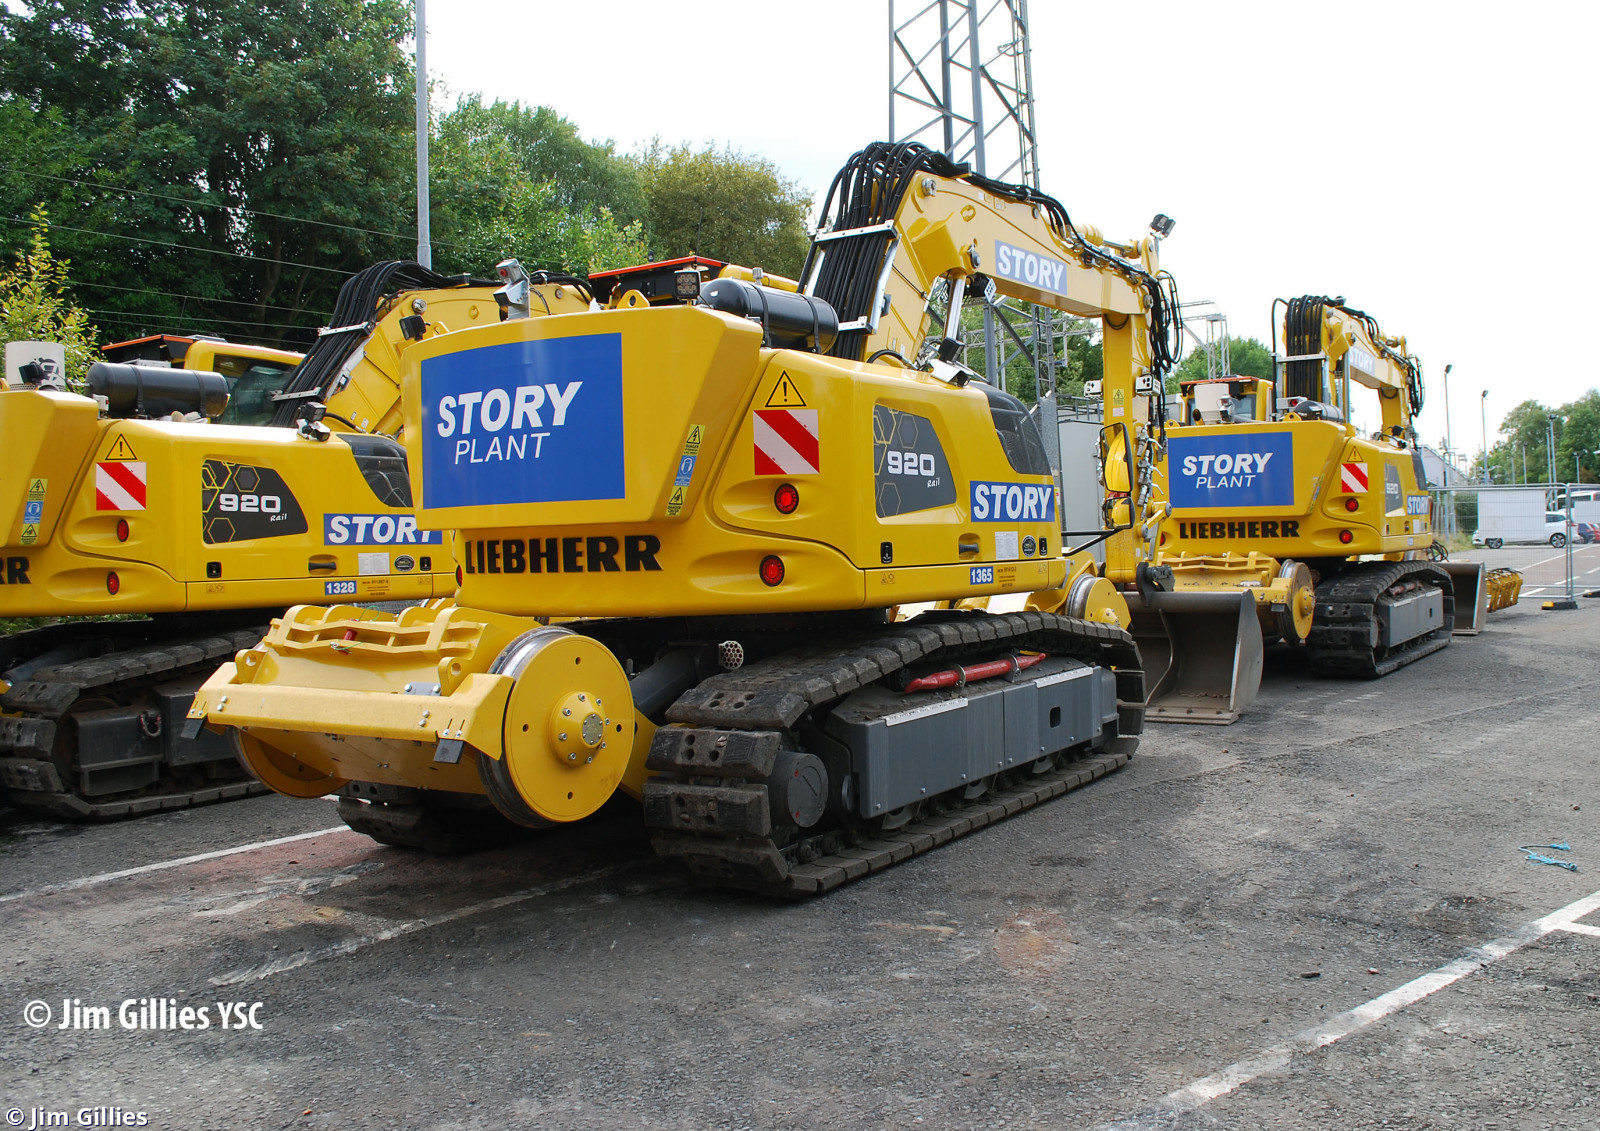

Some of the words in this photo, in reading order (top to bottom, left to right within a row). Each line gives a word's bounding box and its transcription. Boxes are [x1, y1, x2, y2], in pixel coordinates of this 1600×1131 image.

[998, 244, 1064, 291] STORY
[437, 381, 584, 438] STORY
[454, 432, 551, 465] PLANT
[887, 451, 936, 476] 920
[1182, 452, 1274, 476] STORY
[1195, 475, 1256, 489] PLANT
[1386, 483, 1399, 494] 920
[220, 493, 281, 513] 920
[973, 483, 1053, 520] STORY
[1179, 520, 1300, 539] LIEBHERR
[465, 535, 664, 574] LIEBHERR
[971, 568, 993, 583] 1365
[326, 581, 355, 595] 1328
